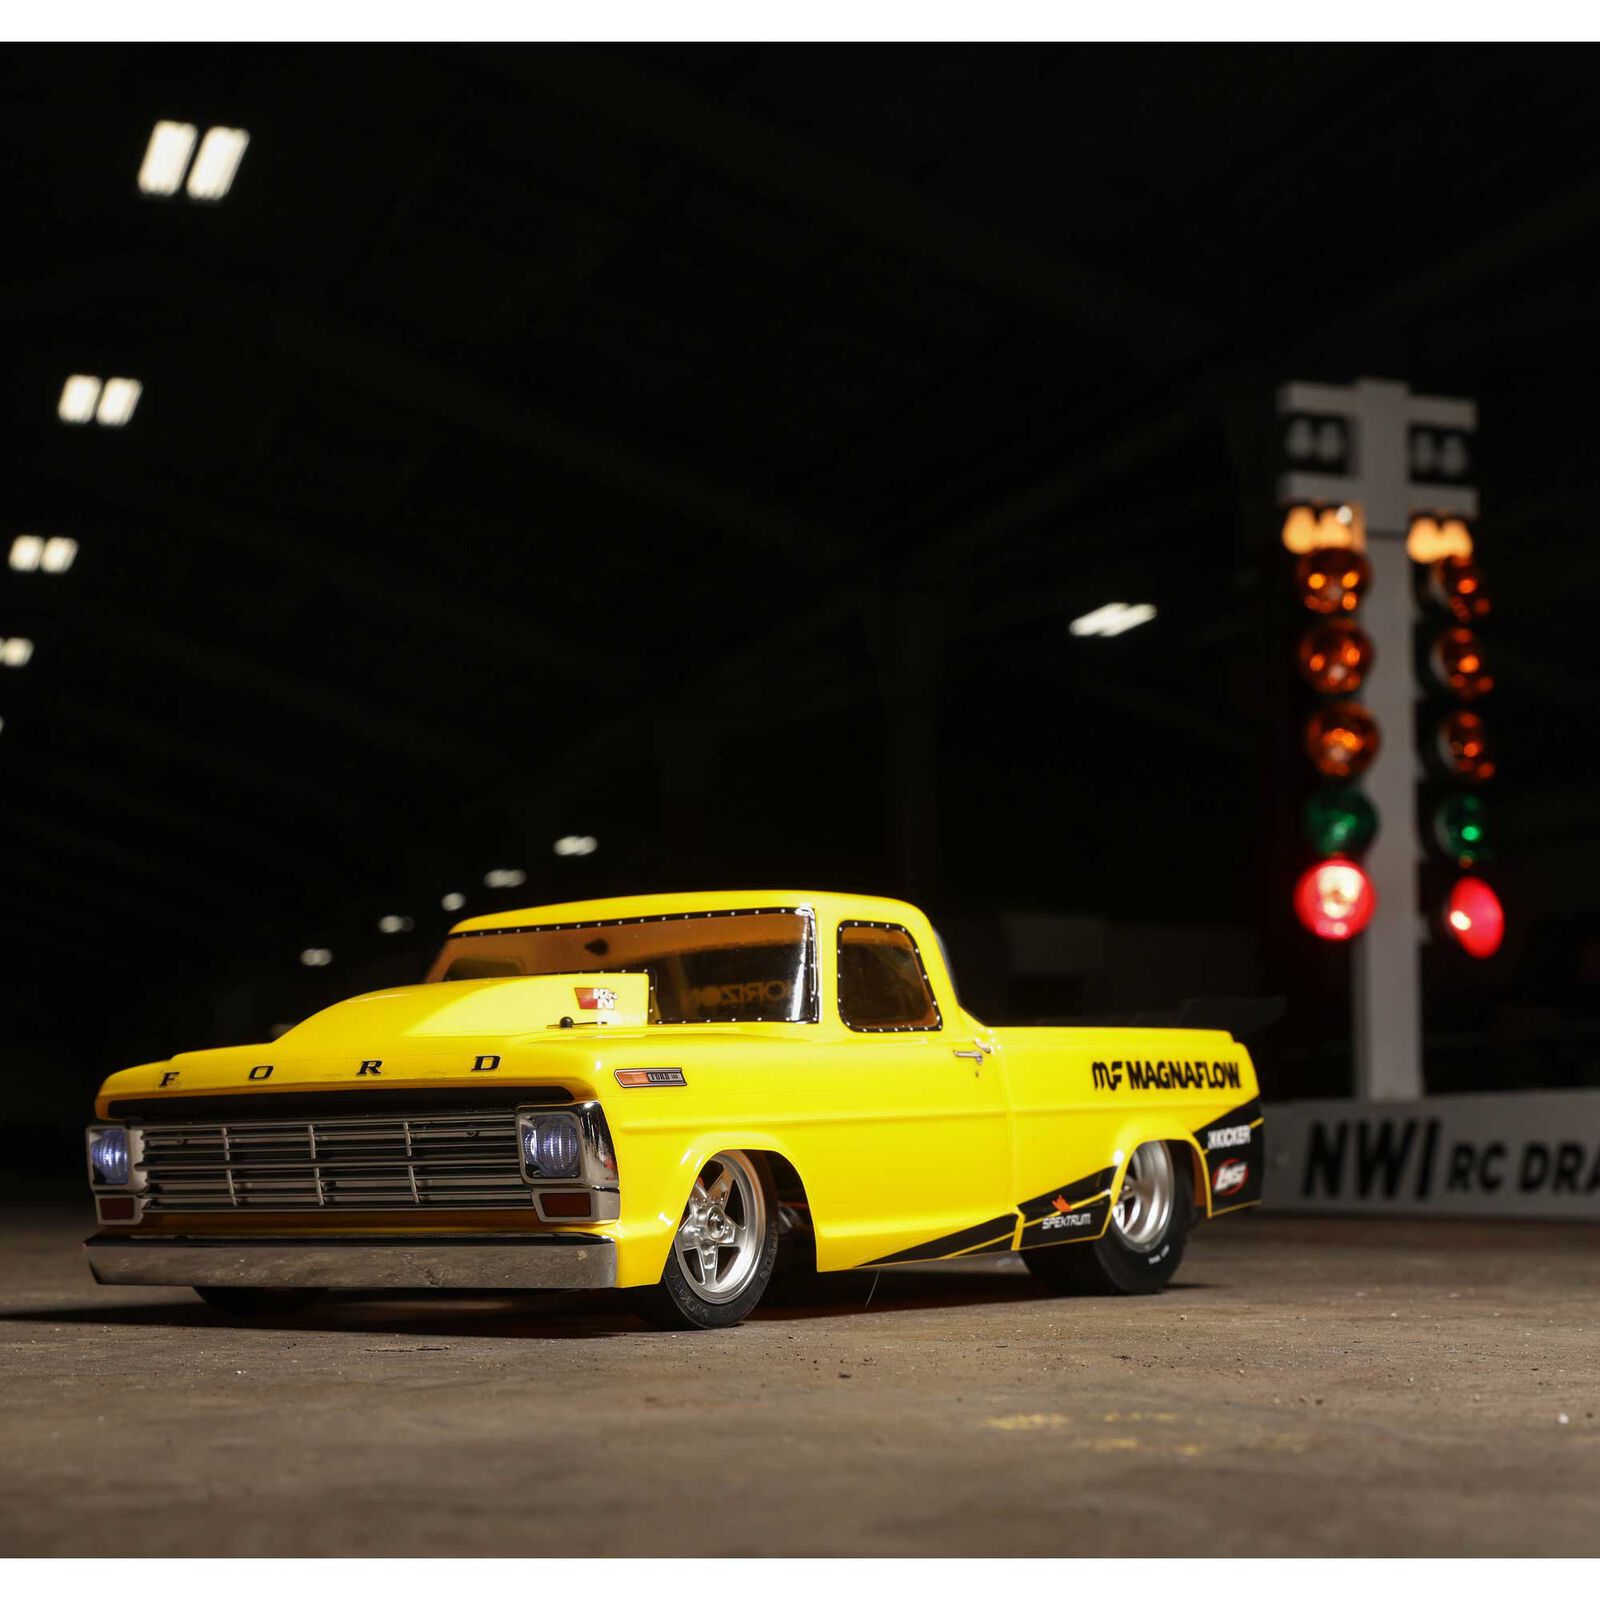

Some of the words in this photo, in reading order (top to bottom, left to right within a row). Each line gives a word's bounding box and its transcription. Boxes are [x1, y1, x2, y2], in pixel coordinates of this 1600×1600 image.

[159, 1054, 501, 1088] FORD
[1126, 1060, 1241, 1090] MAGNAFLOW
[1300, 1116, 1443, 1201] NWI
[1447, 1140, 1509, 1195] RC
[1042, 1212, 1091, 1230] SPEKTRUM
